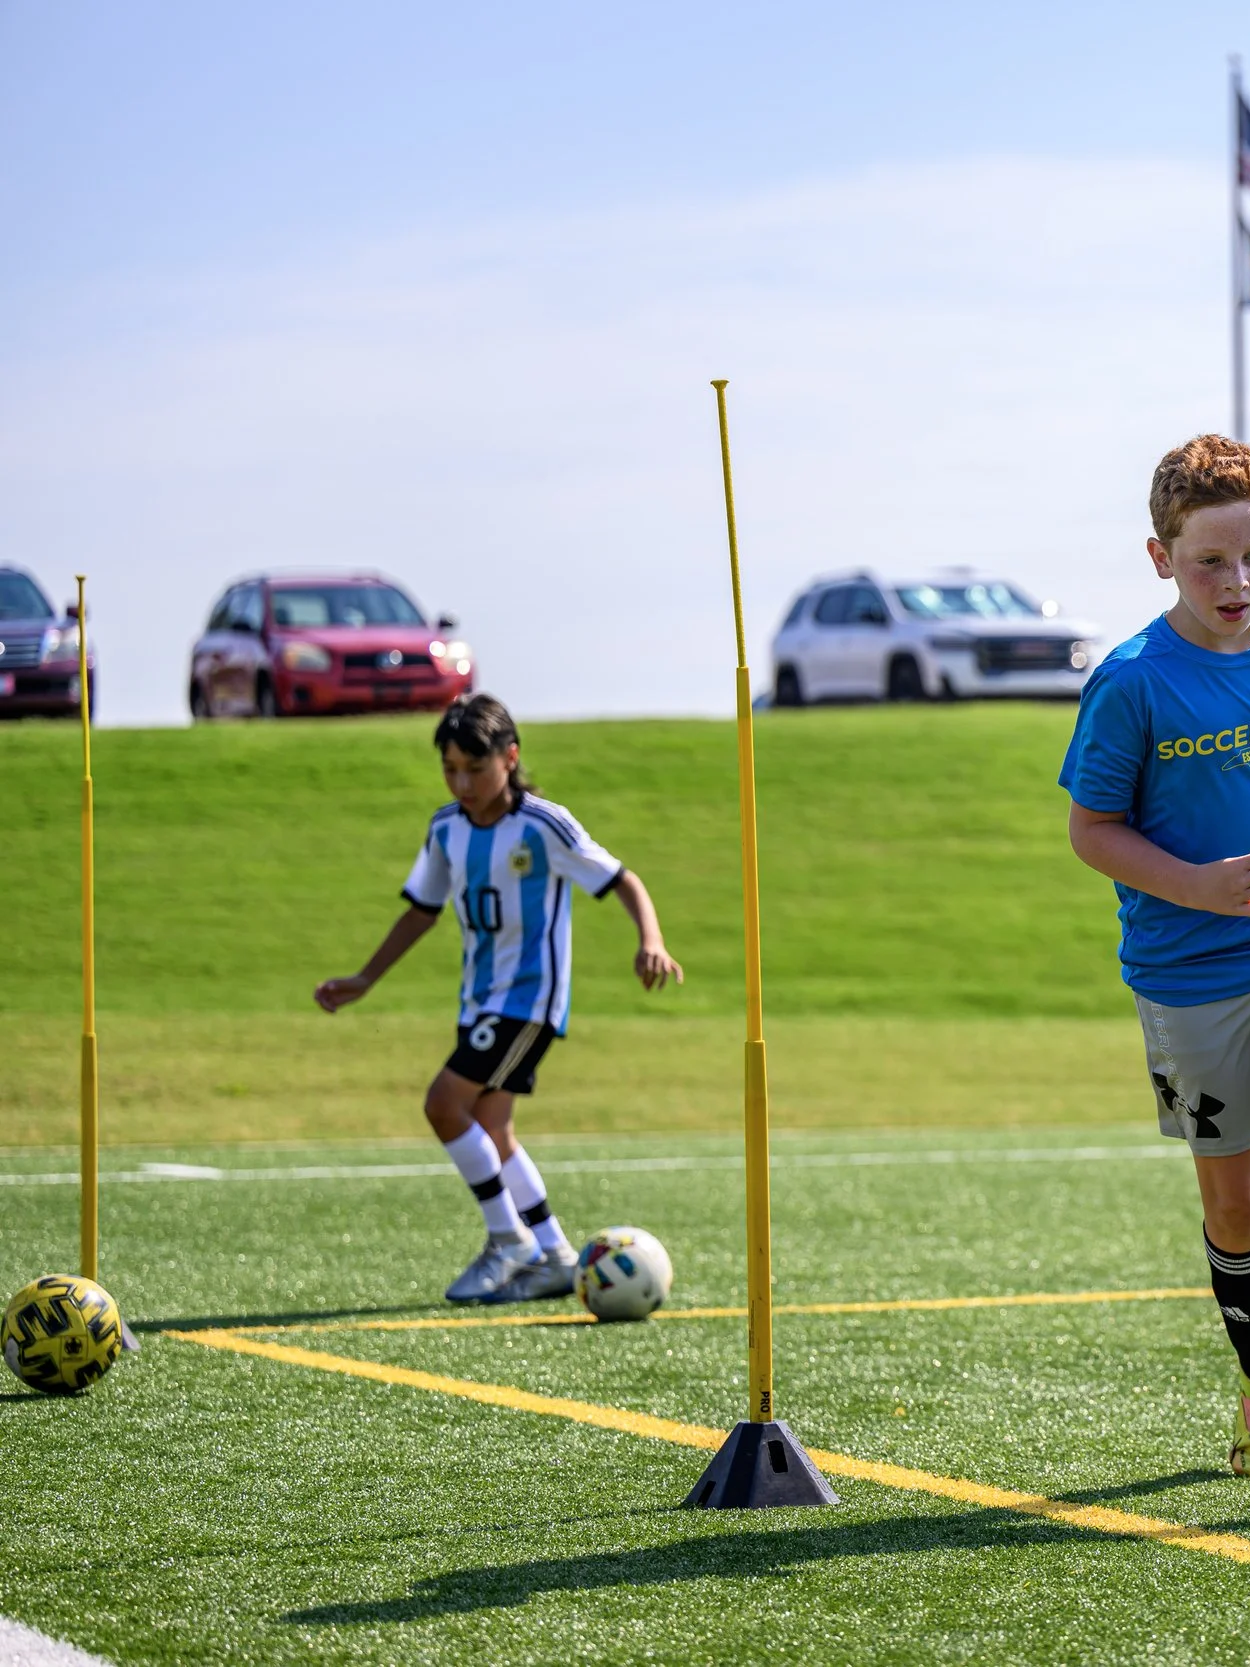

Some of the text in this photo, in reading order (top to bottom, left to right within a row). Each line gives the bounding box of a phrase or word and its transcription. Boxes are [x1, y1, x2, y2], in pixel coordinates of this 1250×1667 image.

[462, 886, 503, 932] 10
[469, 1015, 501, 1052] 6
[760, 1391, 771, 1413] PRO
